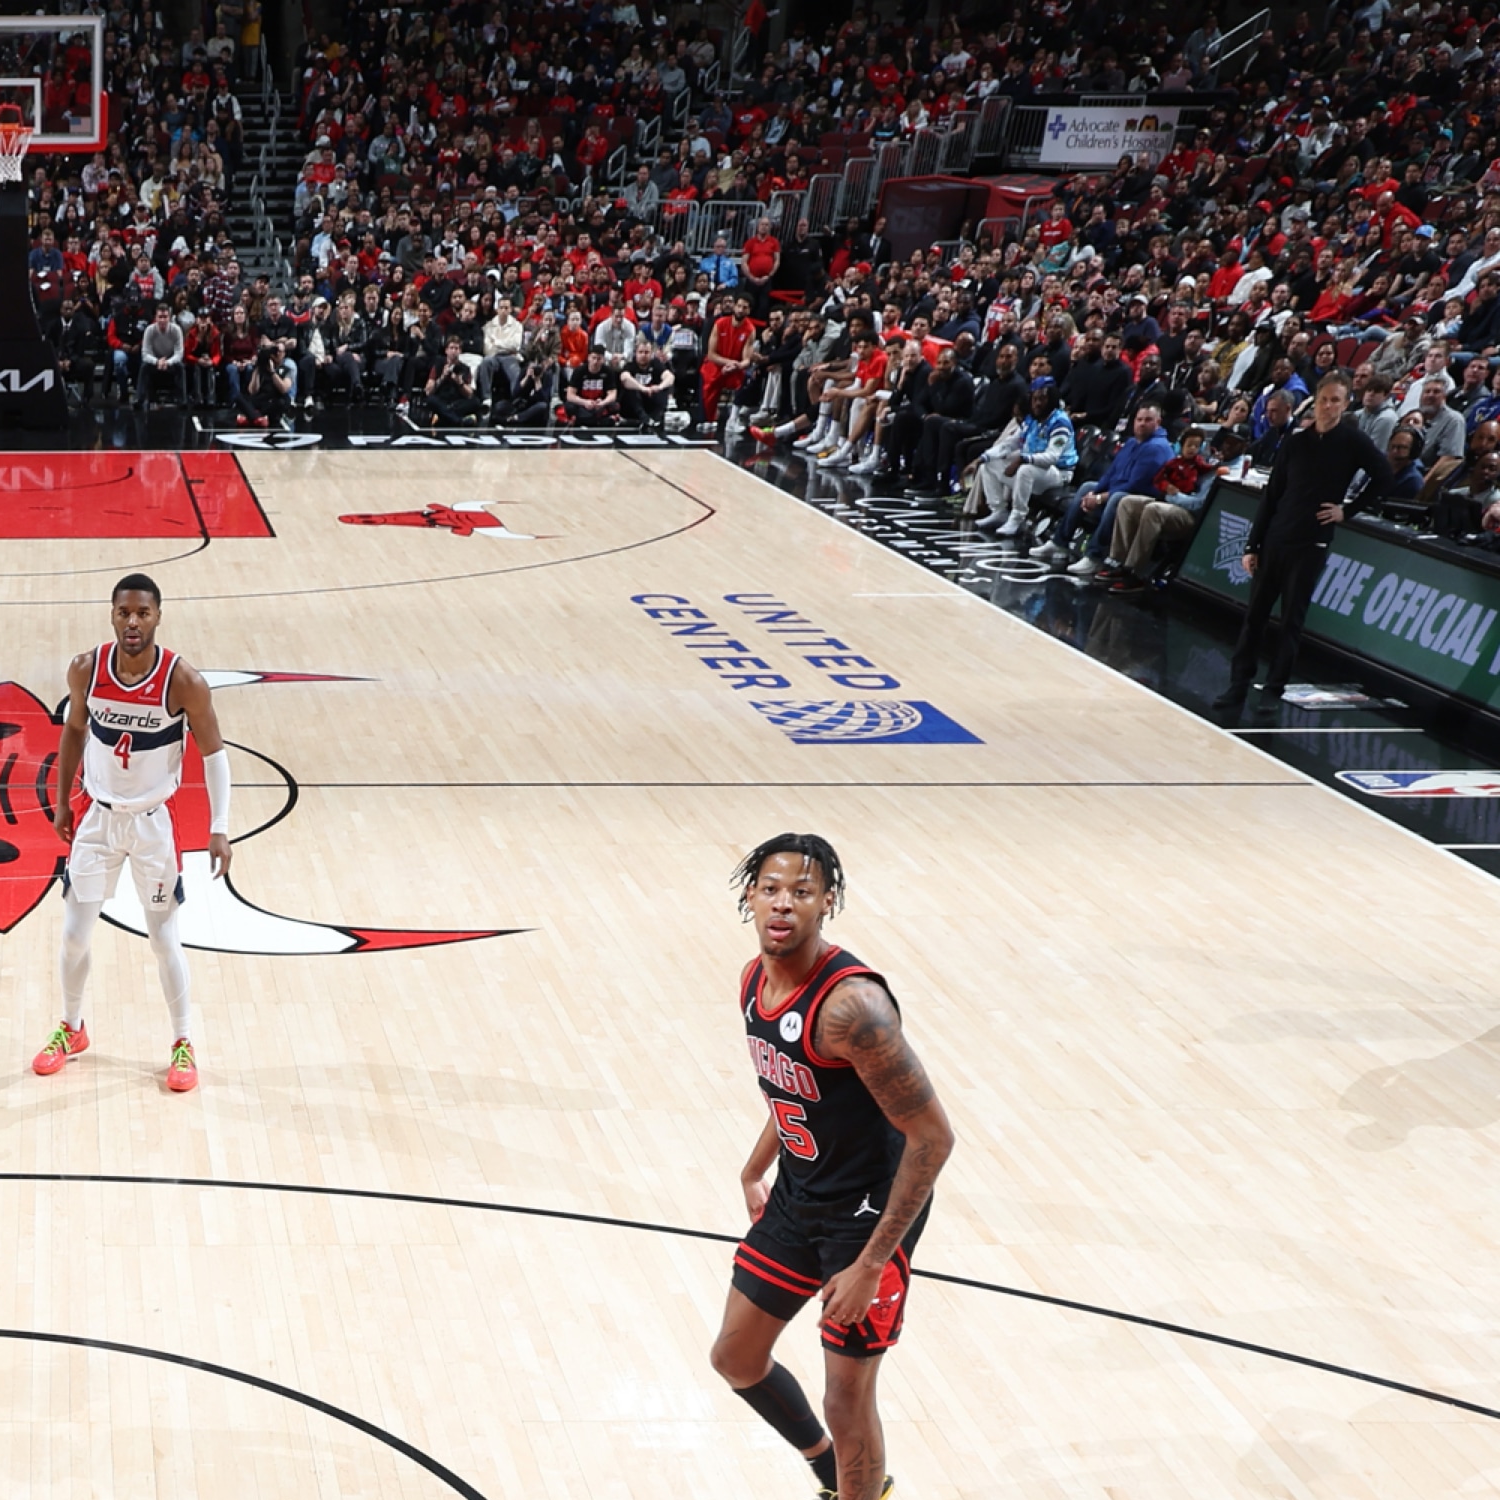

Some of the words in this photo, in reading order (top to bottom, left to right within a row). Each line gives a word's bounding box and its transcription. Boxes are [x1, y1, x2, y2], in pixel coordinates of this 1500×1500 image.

[1066, 134, 1118, 149] Children's
[1121, 133, 1170, 152] Hospital
[1068, 117, 1120, 133] Advocate
[347, 434, 719, 447] FANDUEL
[811, 497, 993, 584] INVESTMENTS
[630, 593, 792, 690] CENTER
[723, 593, 901, 691] UNITED
[1311, 552, 1375, 616] THE
[1362, 572, 1498, 667] OFFICIAL
[113, 731, 133, 770] 4
[763, 1092, 819, 1161] 5
